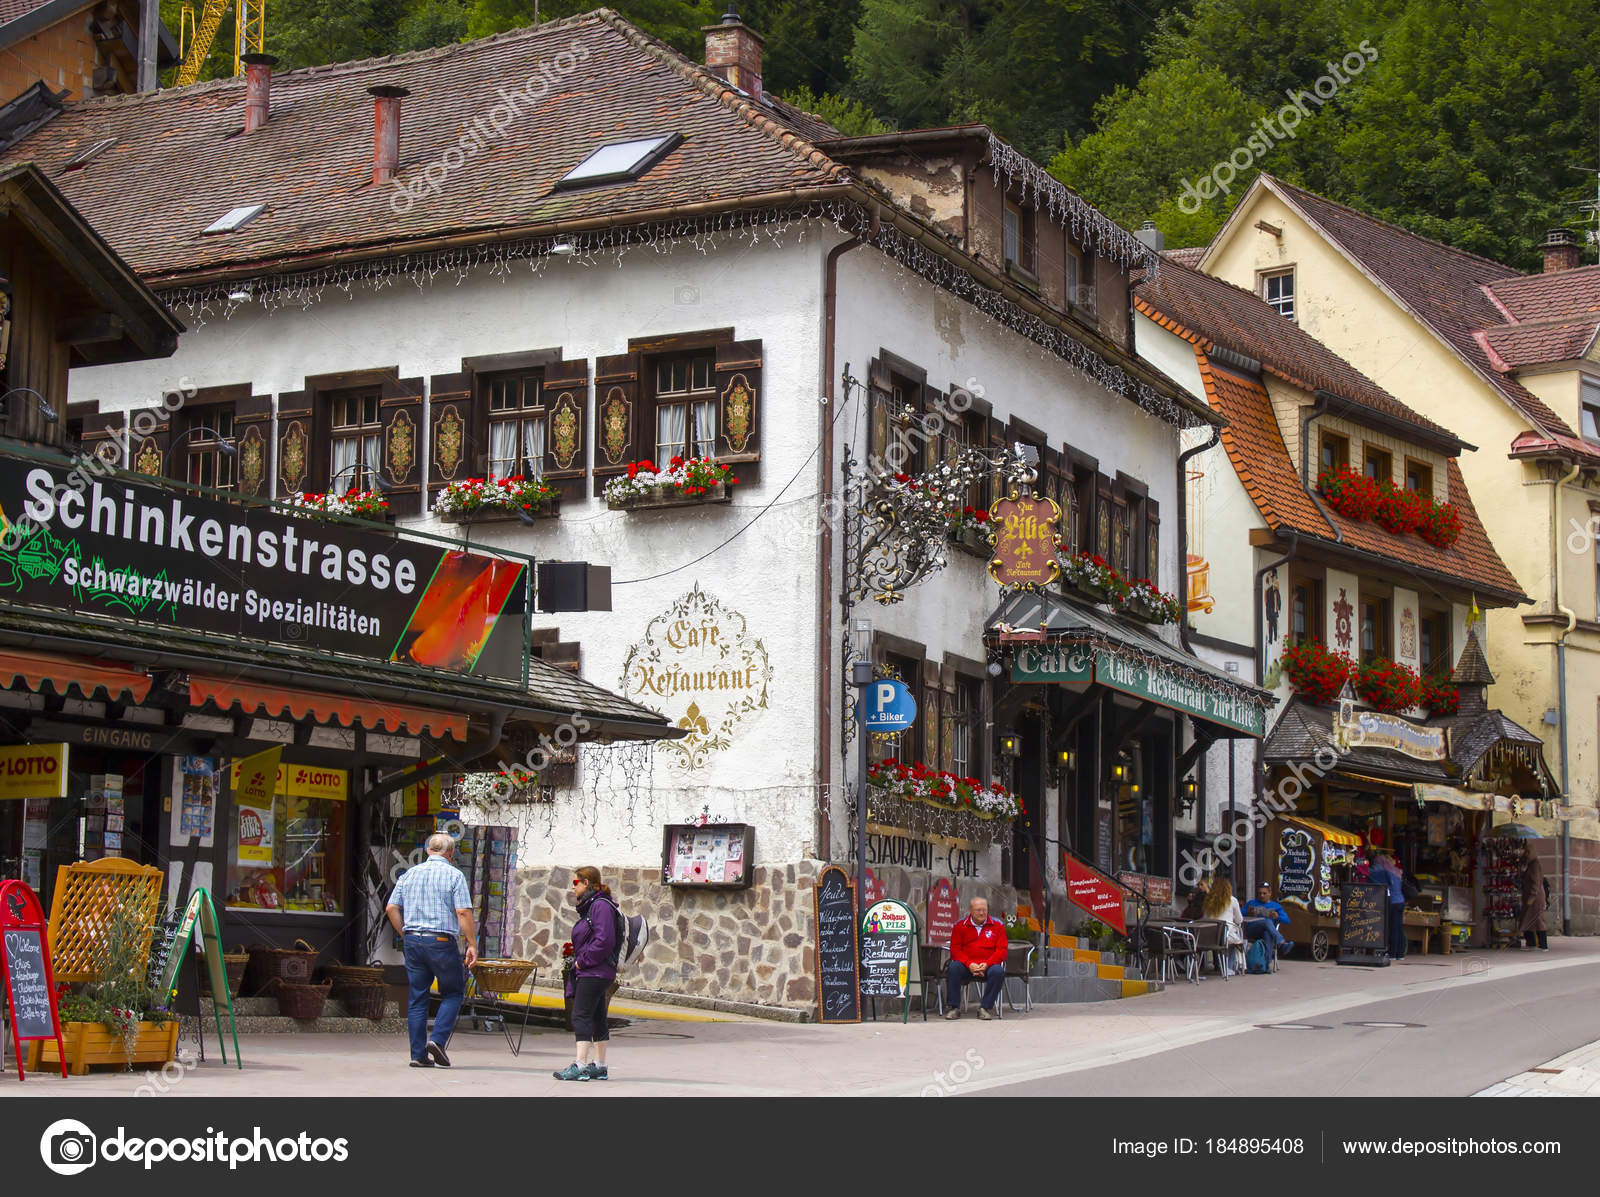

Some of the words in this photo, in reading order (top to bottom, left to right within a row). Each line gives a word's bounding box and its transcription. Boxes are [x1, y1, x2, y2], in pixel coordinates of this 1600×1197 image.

[24, 468, 418, 595] Schinkenstrasse
[1001, 512, 1052, 540] Lilie
[64, 557, 240, 615] Schwarzwälder
[244, 590, 381, 638] Spezialitäten
[632, 659, 760, 704] Restaurant
[877, 683, 895, 712] P
[880, 712, 904, 721] Biker
[83, 727, 152, 749] EINGANG
[8, 756, 57, 776] LOTTO
[309, 771, 341, 787] LOTTO
[245, 787, 266, 798] LOTTO
[848, 829, 936, 870] RSTAURANT
[820, 881, 846, 904] Heute
[881, 912, 906, 922] Rothaus
[862, 946, 909, 959] Restaurant
[864, 937, 887, 947] Zum
[868, 965, 896, 974] Terrasse
